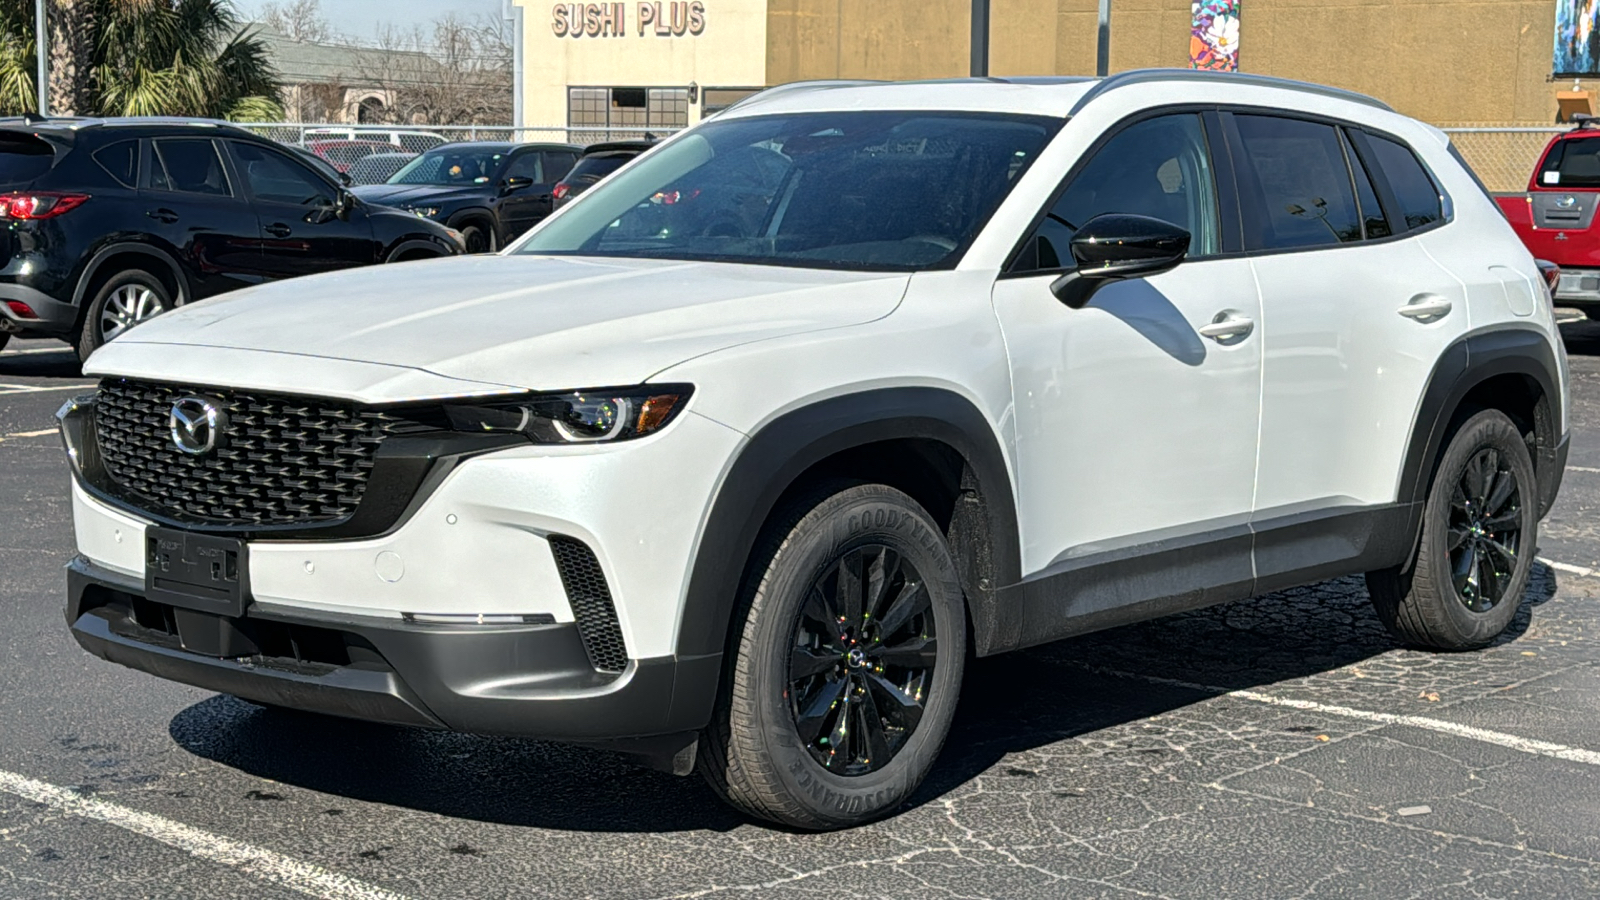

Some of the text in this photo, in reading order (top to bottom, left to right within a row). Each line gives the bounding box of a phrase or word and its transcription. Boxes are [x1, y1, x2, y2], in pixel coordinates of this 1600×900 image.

[551, 1, 705, 38] SUSHI PLUS
[846, 508, 950, 571] GOODYEAR
